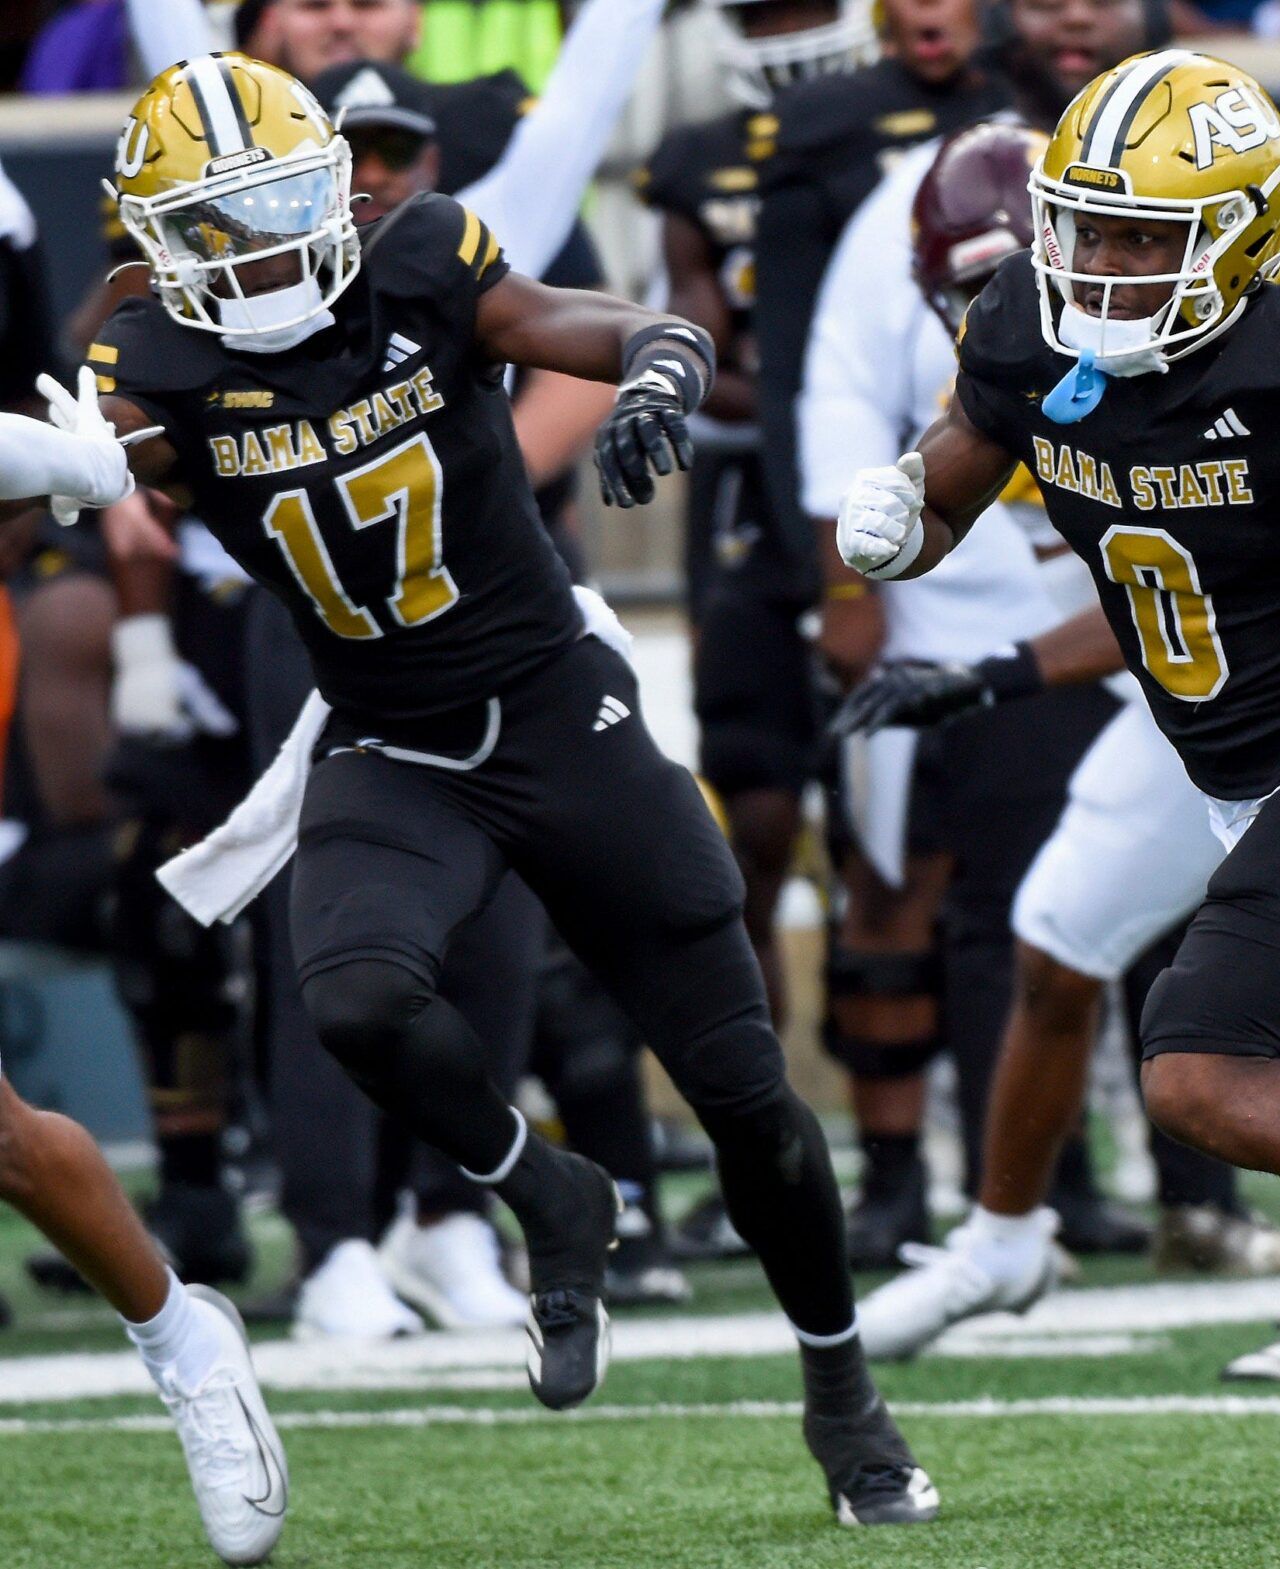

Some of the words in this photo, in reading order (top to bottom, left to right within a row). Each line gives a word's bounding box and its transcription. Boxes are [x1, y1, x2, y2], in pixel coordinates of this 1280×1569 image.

[1069, 166, 1119, 187] HORNETS
[1043, 226, 1066, 272] Riddel
[209, 418, 327, 477] BAMA
[328, 365, 445, 455] STATE
[1032, 435, 1122, 508] BAMA
[1129, 459, 1254, 511] STATE
[261, 431, 460, 640] 17
[1098, 524, 1230, 702] 0
